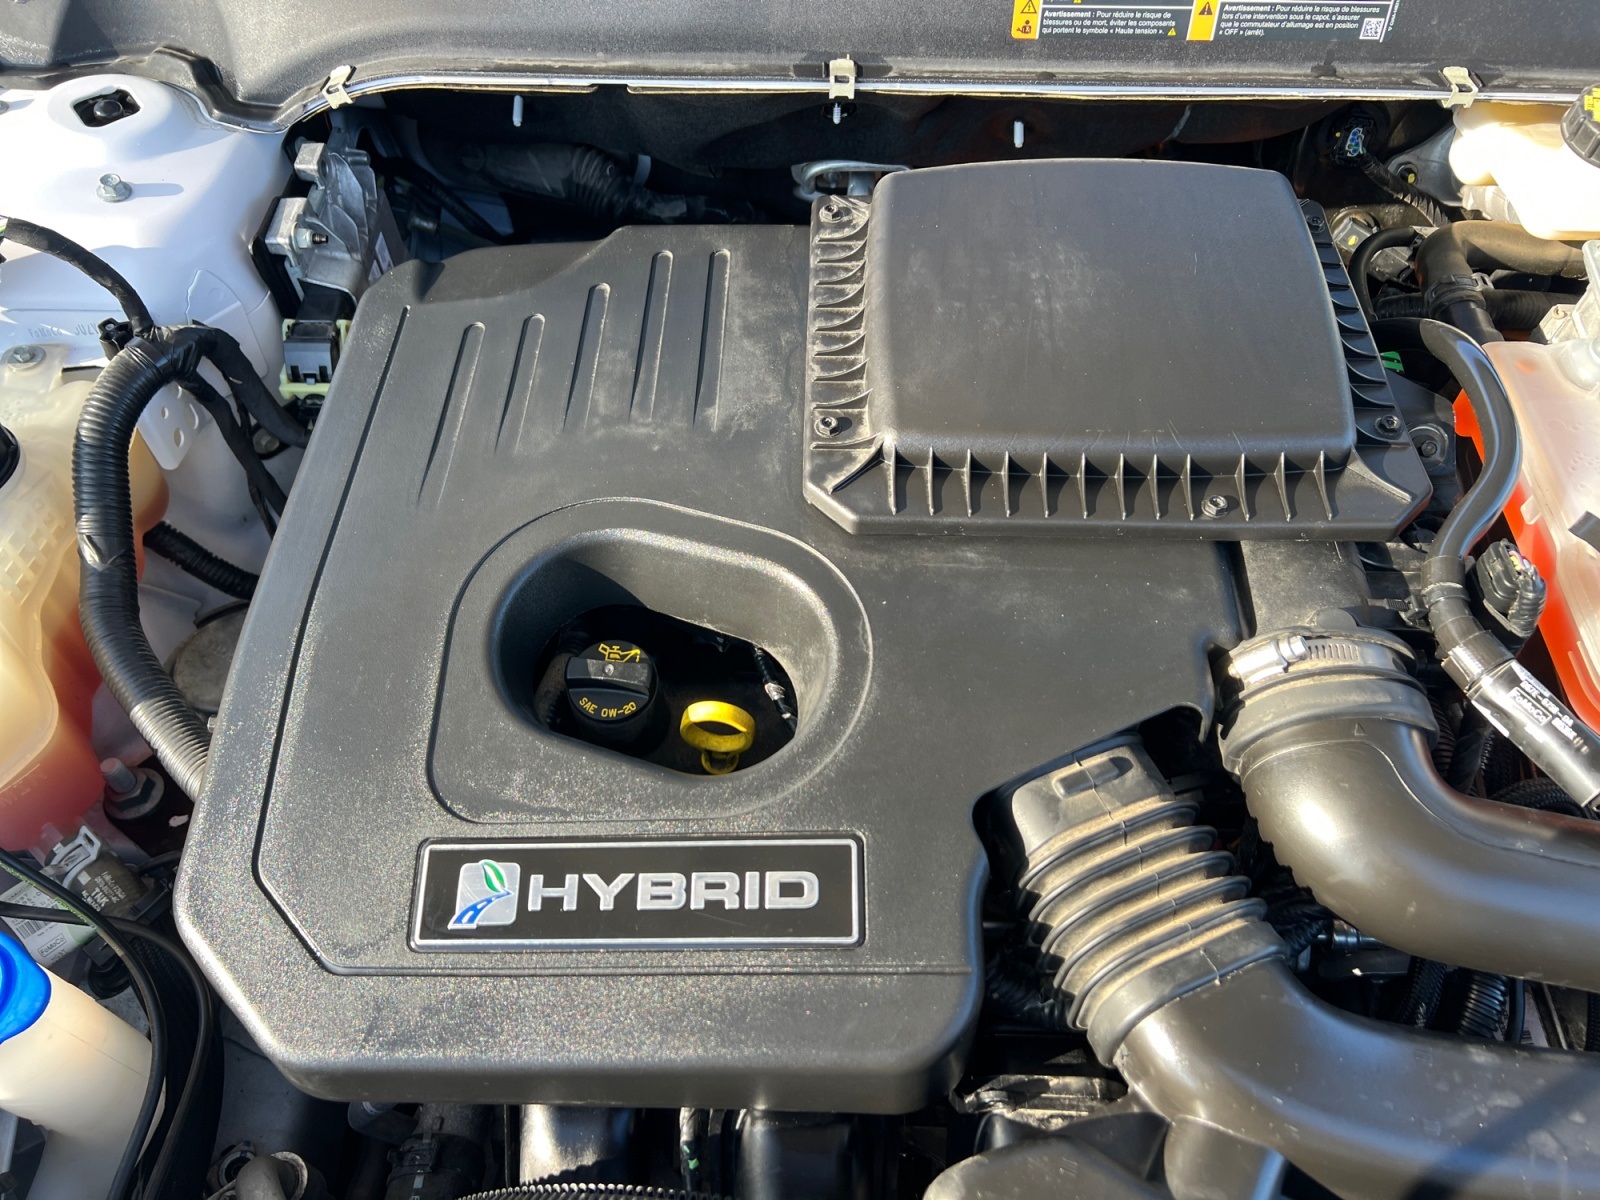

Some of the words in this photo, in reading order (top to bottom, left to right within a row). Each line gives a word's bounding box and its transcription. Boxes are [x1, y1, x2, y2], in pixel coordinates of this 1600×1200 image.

[1224, 4, 1271, 12] Avertissement
[1321, 5, 1341, 13] risque
[1044, 10, 1091, 18] Avertissement
[1142, 11, 1162, 19] risque
[1043, 18, 1073, 26] blessures
[1280, 21, 1314, 29] d'allumage
[1082, 27, 1109, 35] symbole
[1135, 27, 1158, 35] tension
[579, 697, 598, 715] SAE
[601, 701, 637, 718] 0W-20
[527, 871, 820, 912] HYBRID
[39, 936, 65, 955] FoMoCo
